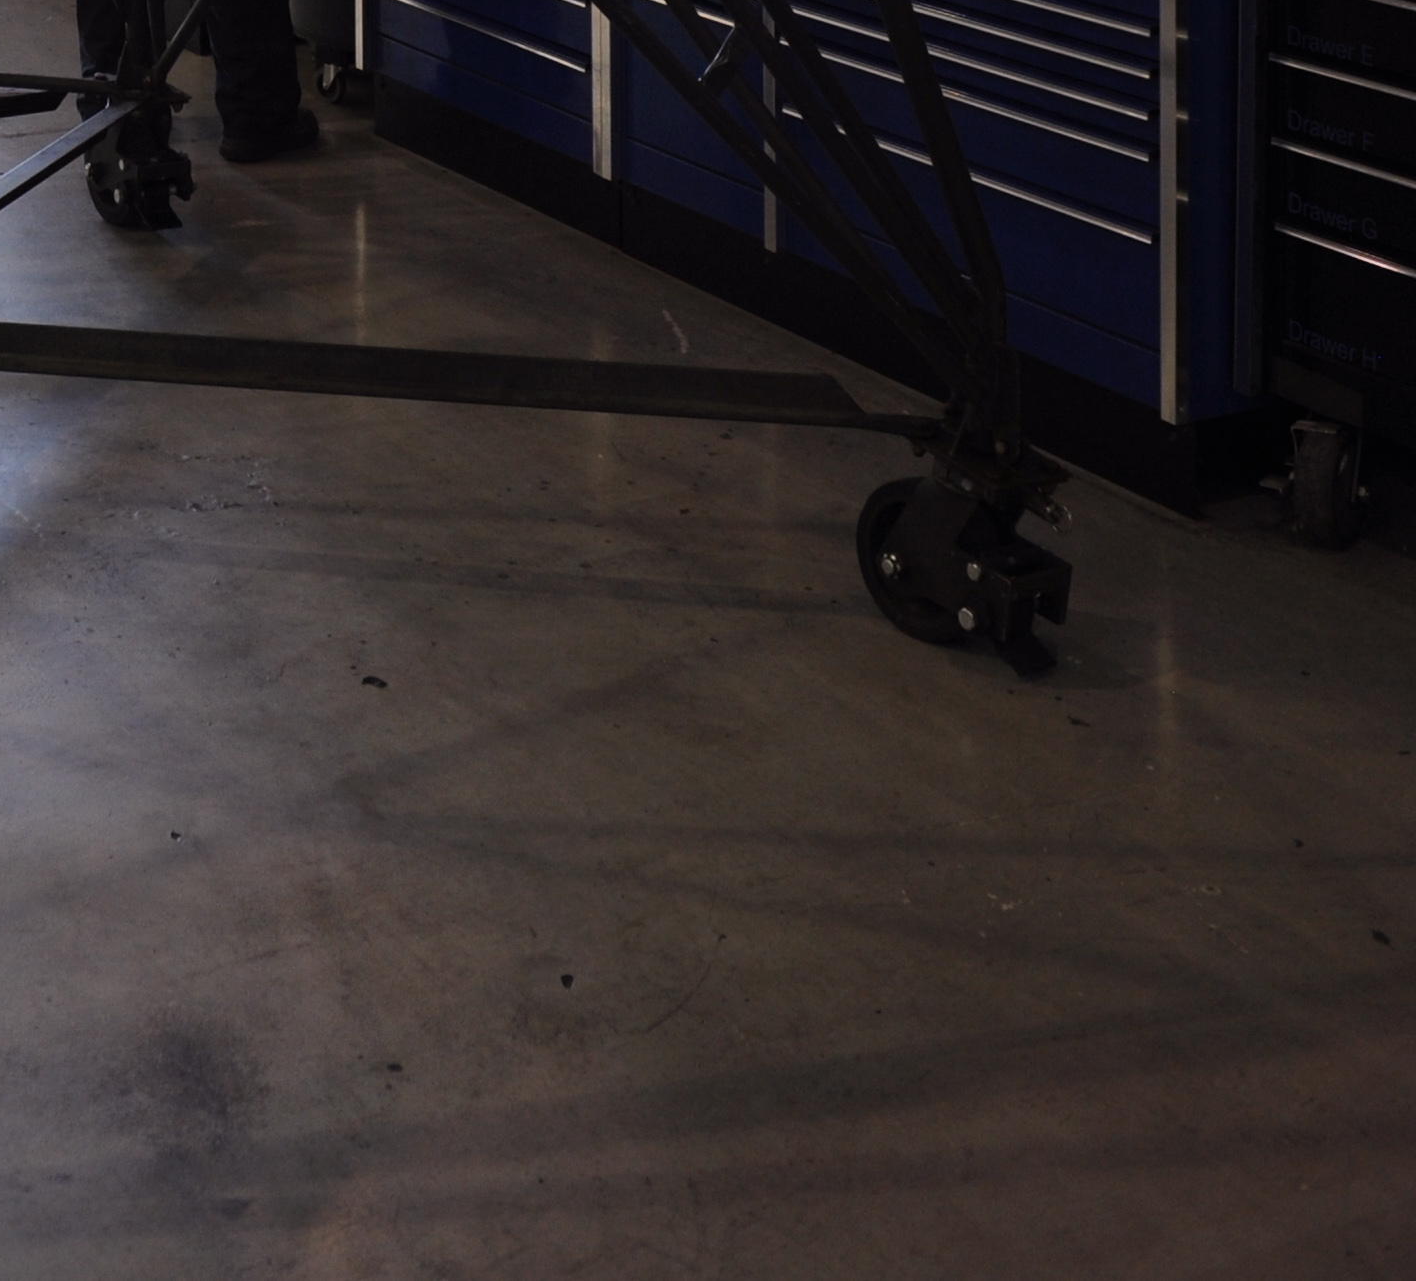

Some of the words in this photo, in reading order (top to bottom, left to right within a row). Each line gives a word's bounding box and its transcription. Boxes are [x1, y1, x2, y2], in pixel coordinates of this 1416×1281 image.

[1287, 25, 1355, 61] Drawer
[1361, 43, 1374, 67] E
[1287, 108, 1355, 148] Drawer
[1361, 130, 1376, 152] F
[1287, 191, 1359, 233] Drawer
[1361, 217, 1378, 240] G
[1288, 319, 1358, 362] Drawer
[1362, 347, 1378, 372] H
